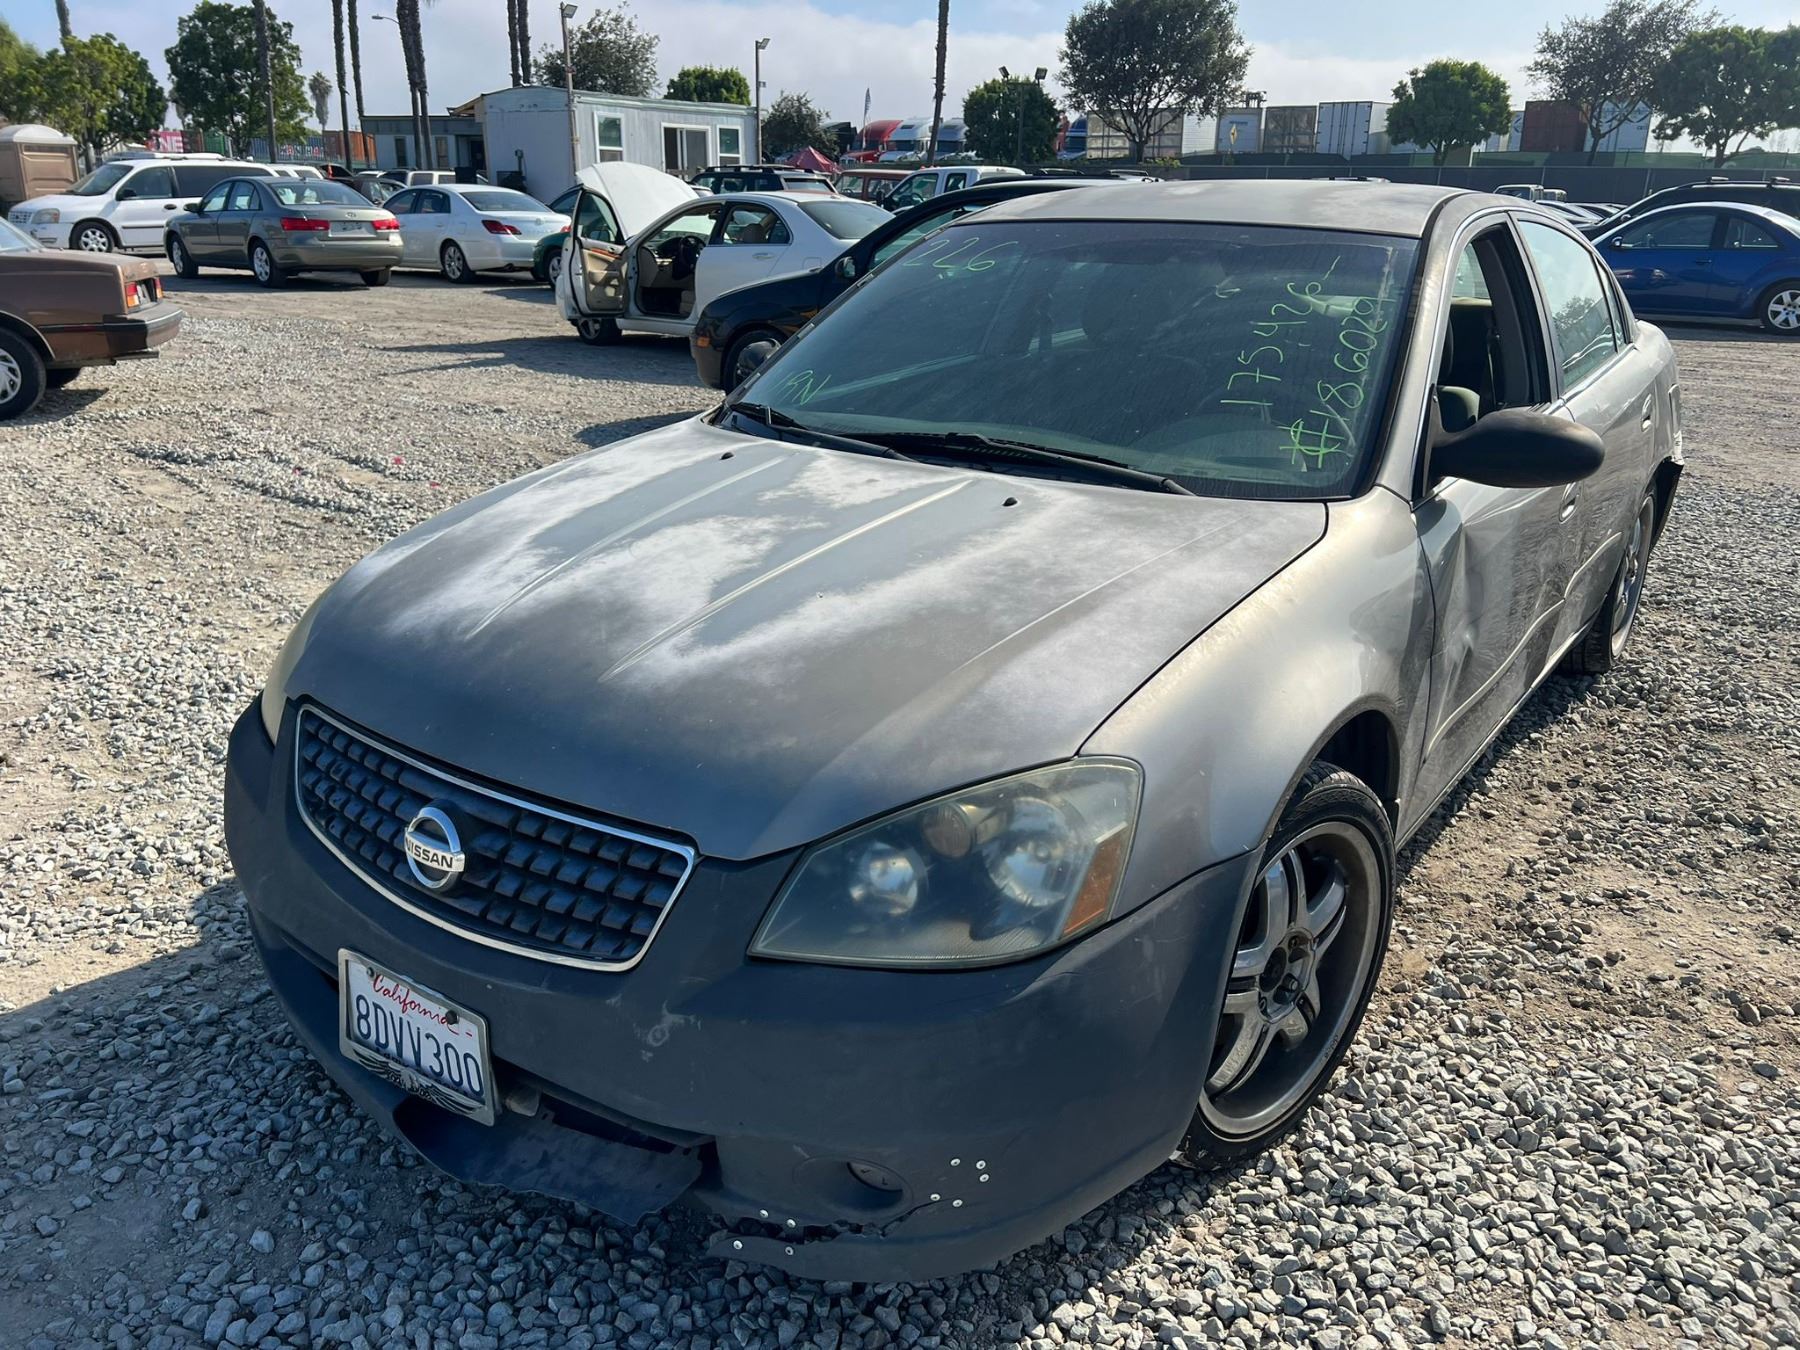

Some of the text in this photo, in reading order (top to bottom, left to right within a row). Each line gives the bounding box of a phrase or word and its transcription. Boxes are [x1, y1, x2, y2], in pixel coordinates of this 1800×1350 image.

[902, 236, 1020, 272] 226
[405, 836, 453, 869] NISSAN
[372, 974, 459, 1035] California
[355, 993, 485, 1098] 8DVV300
